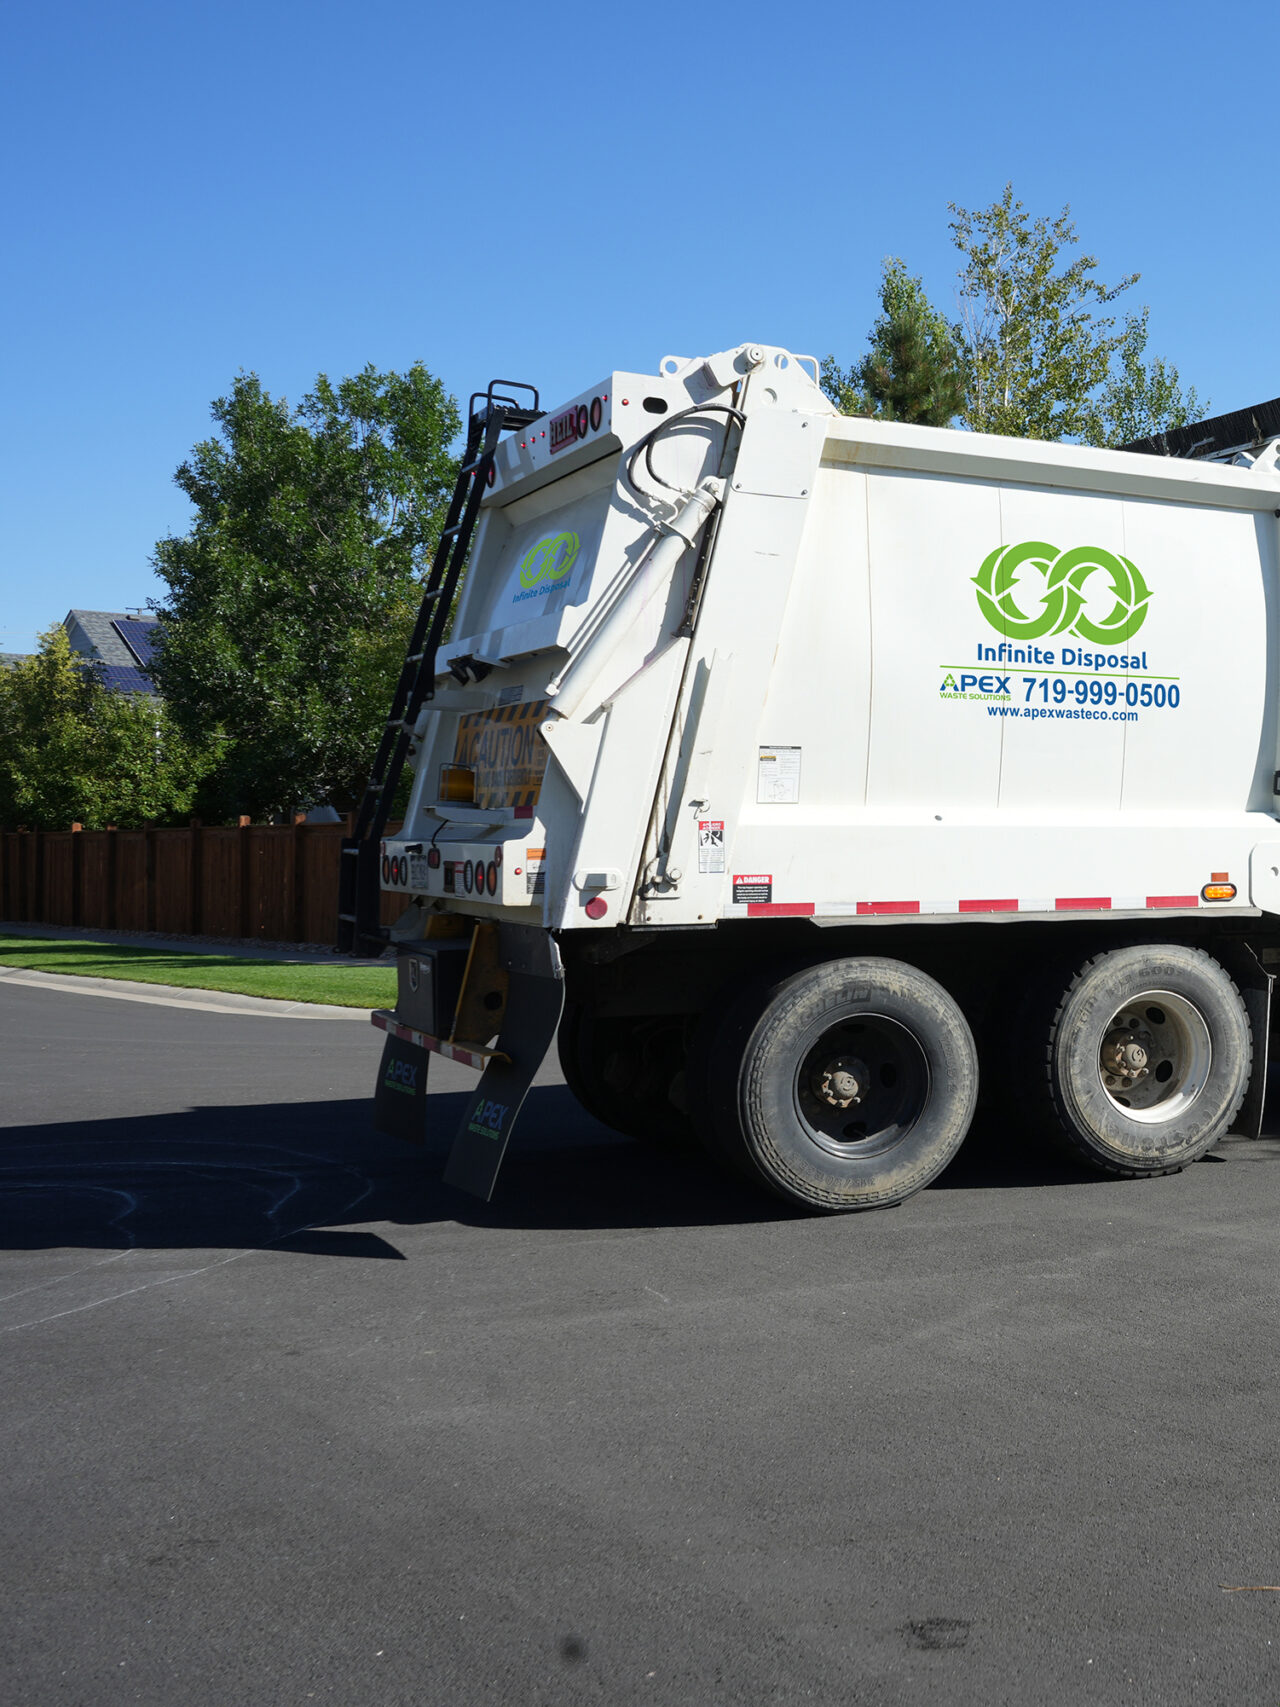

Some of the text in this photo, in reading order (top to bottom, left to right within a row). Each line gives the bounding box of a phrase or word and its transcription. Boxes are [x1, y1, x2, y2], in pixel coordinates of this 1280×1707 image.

[513, 578, 571, 603] Infinite Disposal
[977, 643, 1148, 671] Infinite Disposal
[939, 673, 1011, 695] APEX
[1022, 677, 1180, 708] 719-999-0500
[969, 693, 1011, 702] SOLUTIONS
[987, 705, 1139, 721] www.apexwasteco.com
[468, 724, 536, 769] CAUTION
[744, 876, 769, 884] DANGER
[385, 1058, 418, 1087] APEX
[471, 1098, 509, 1131] APEX
